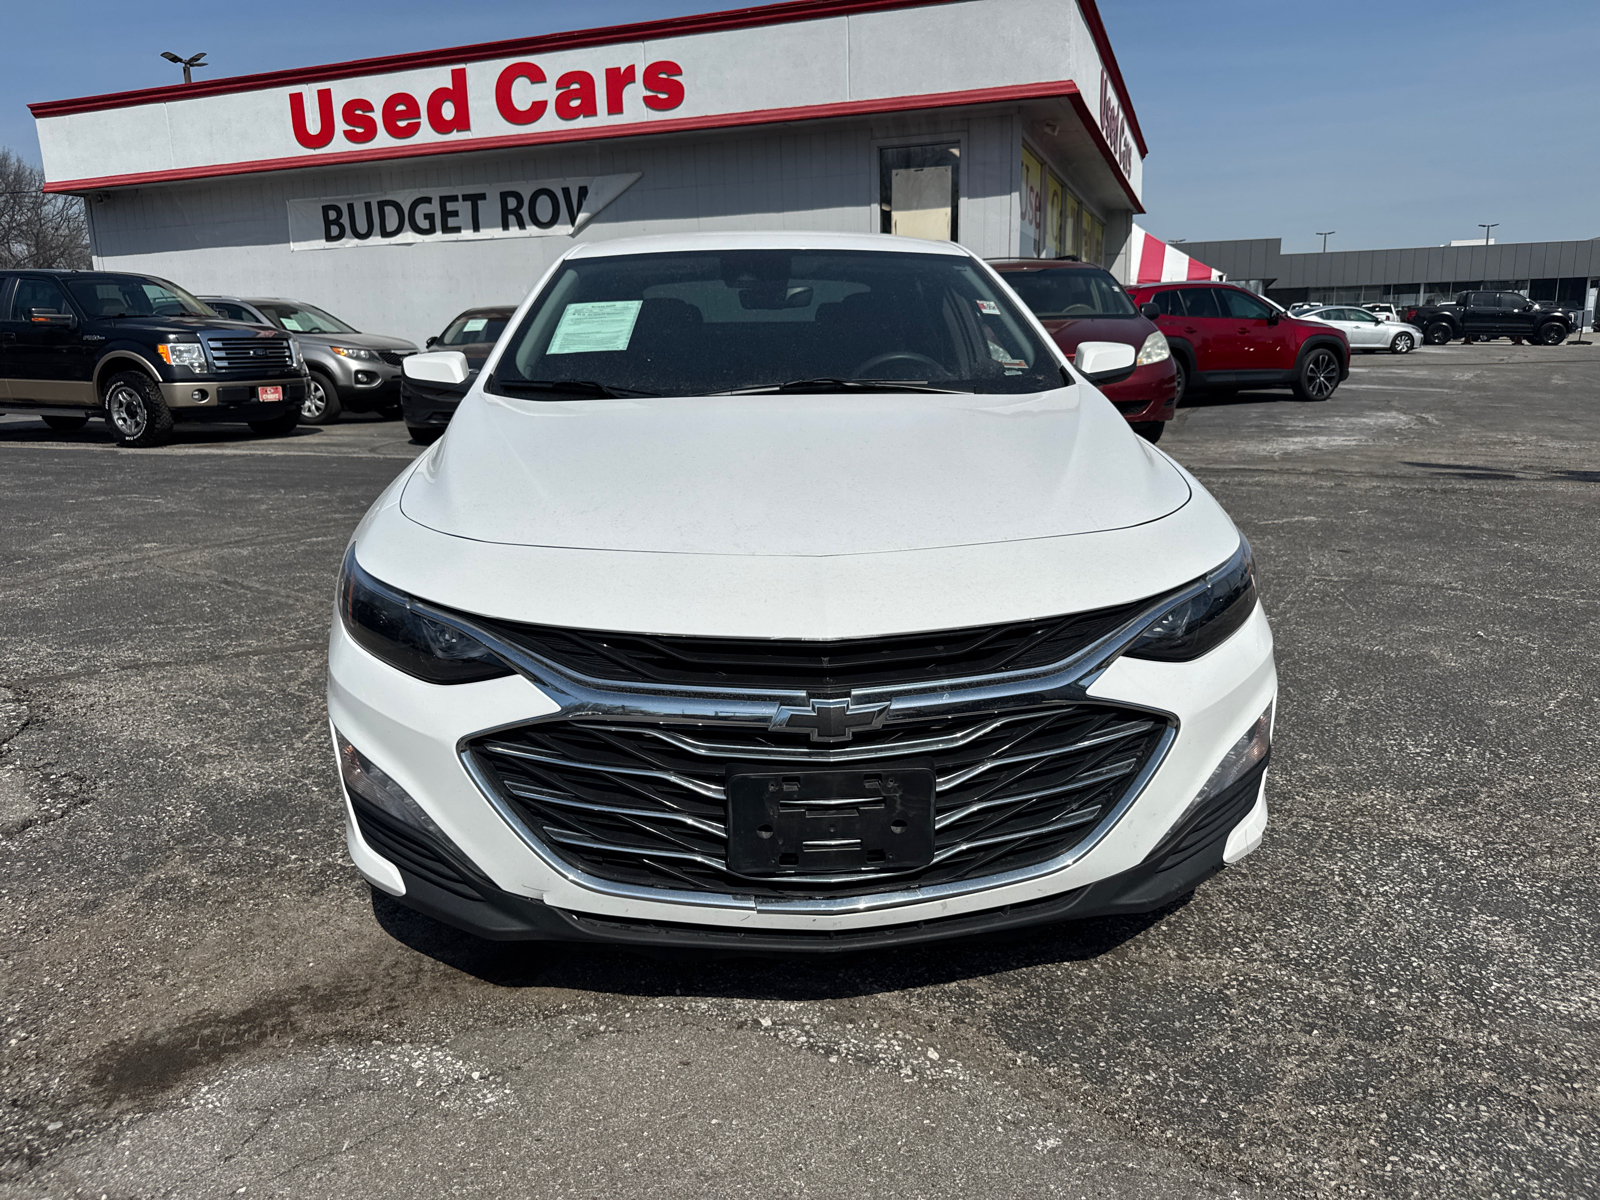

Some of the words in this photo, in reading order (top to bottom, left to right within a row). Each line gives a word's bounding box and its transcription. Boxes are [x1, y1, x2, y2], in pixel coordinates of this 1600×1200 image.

[289, 68, 471, 150] Used
[495, 61, 685, 126] Cars
[1100, 68, 1120, 154] Used
[1119, 116, 1132, 180] Cars
[321, 192, 486, 243] BUDGET
